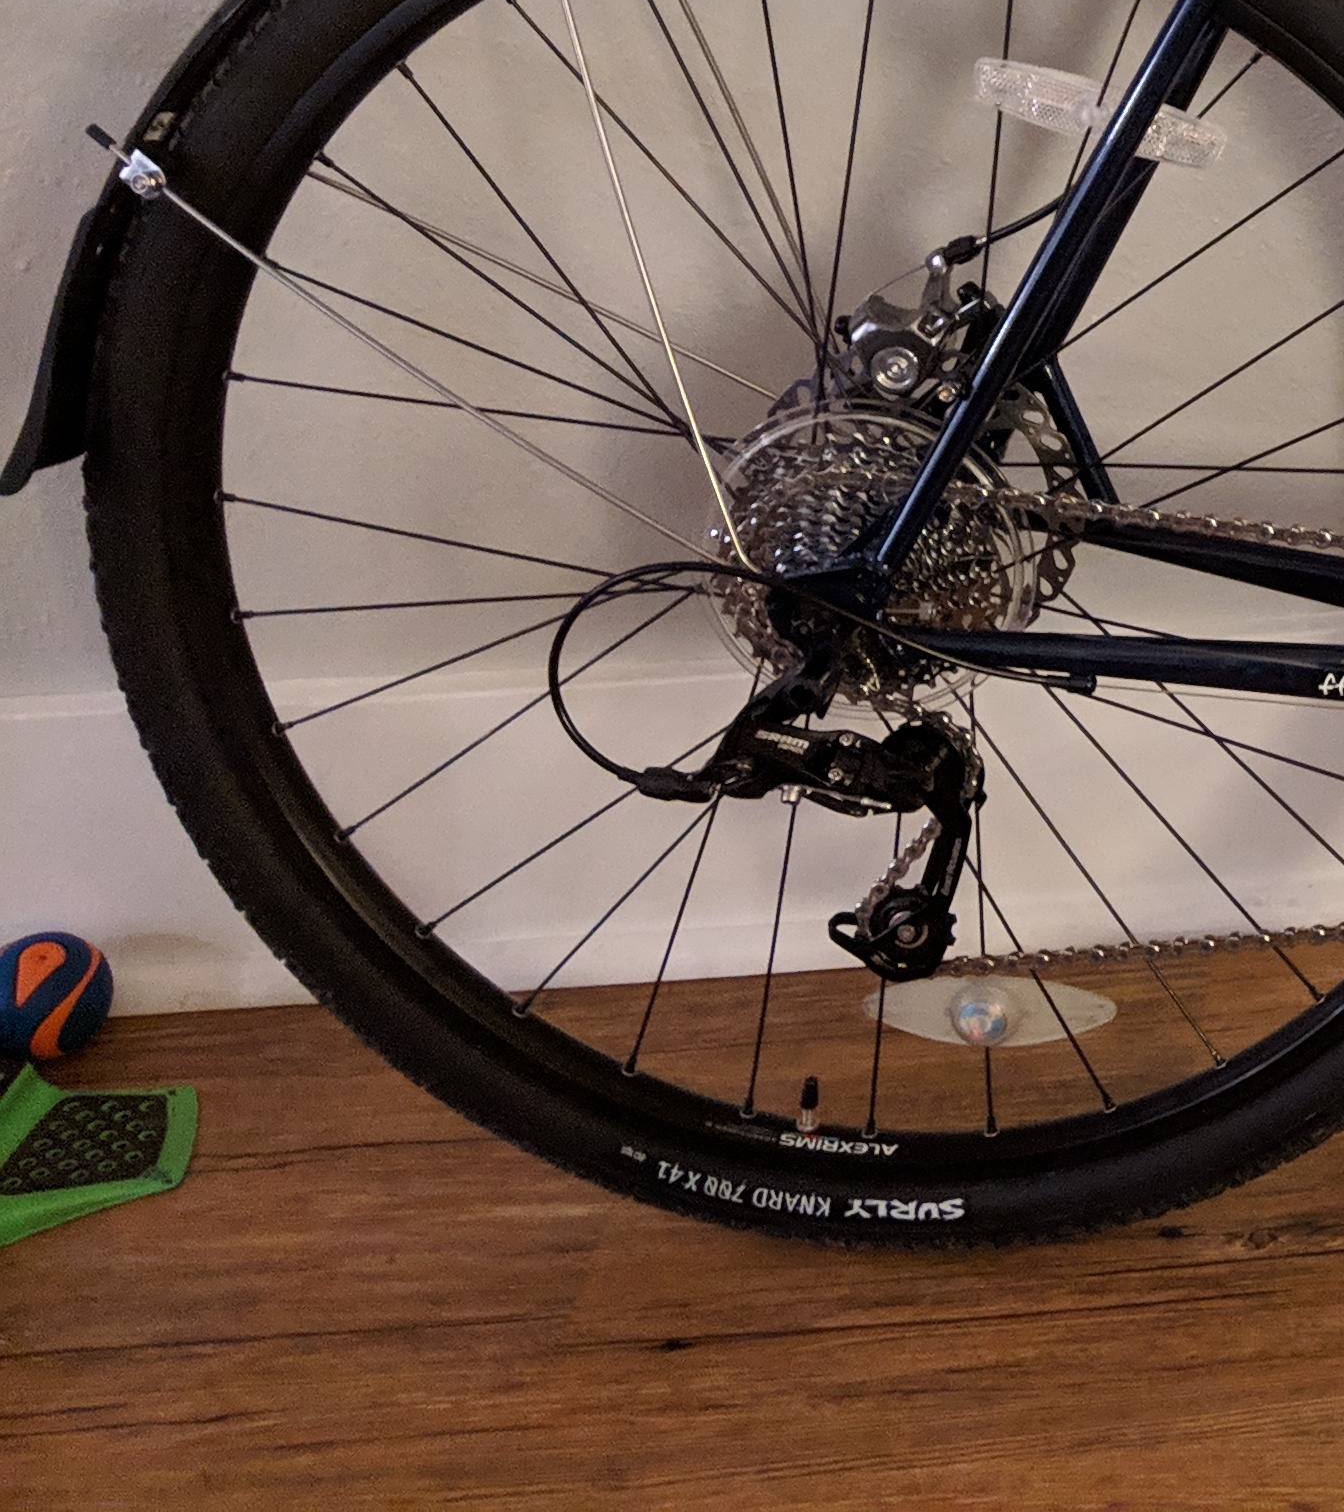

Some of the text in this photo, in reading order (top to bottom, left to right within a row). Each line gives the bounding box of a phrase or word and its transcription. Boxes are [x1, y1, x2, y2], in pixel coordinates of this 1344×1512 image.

[778, 1132, 899, 1157] ALEXRIMS
[751, 1186, 831, 1217] KNARD
[844, 1197, 966, 1221] SURLY
